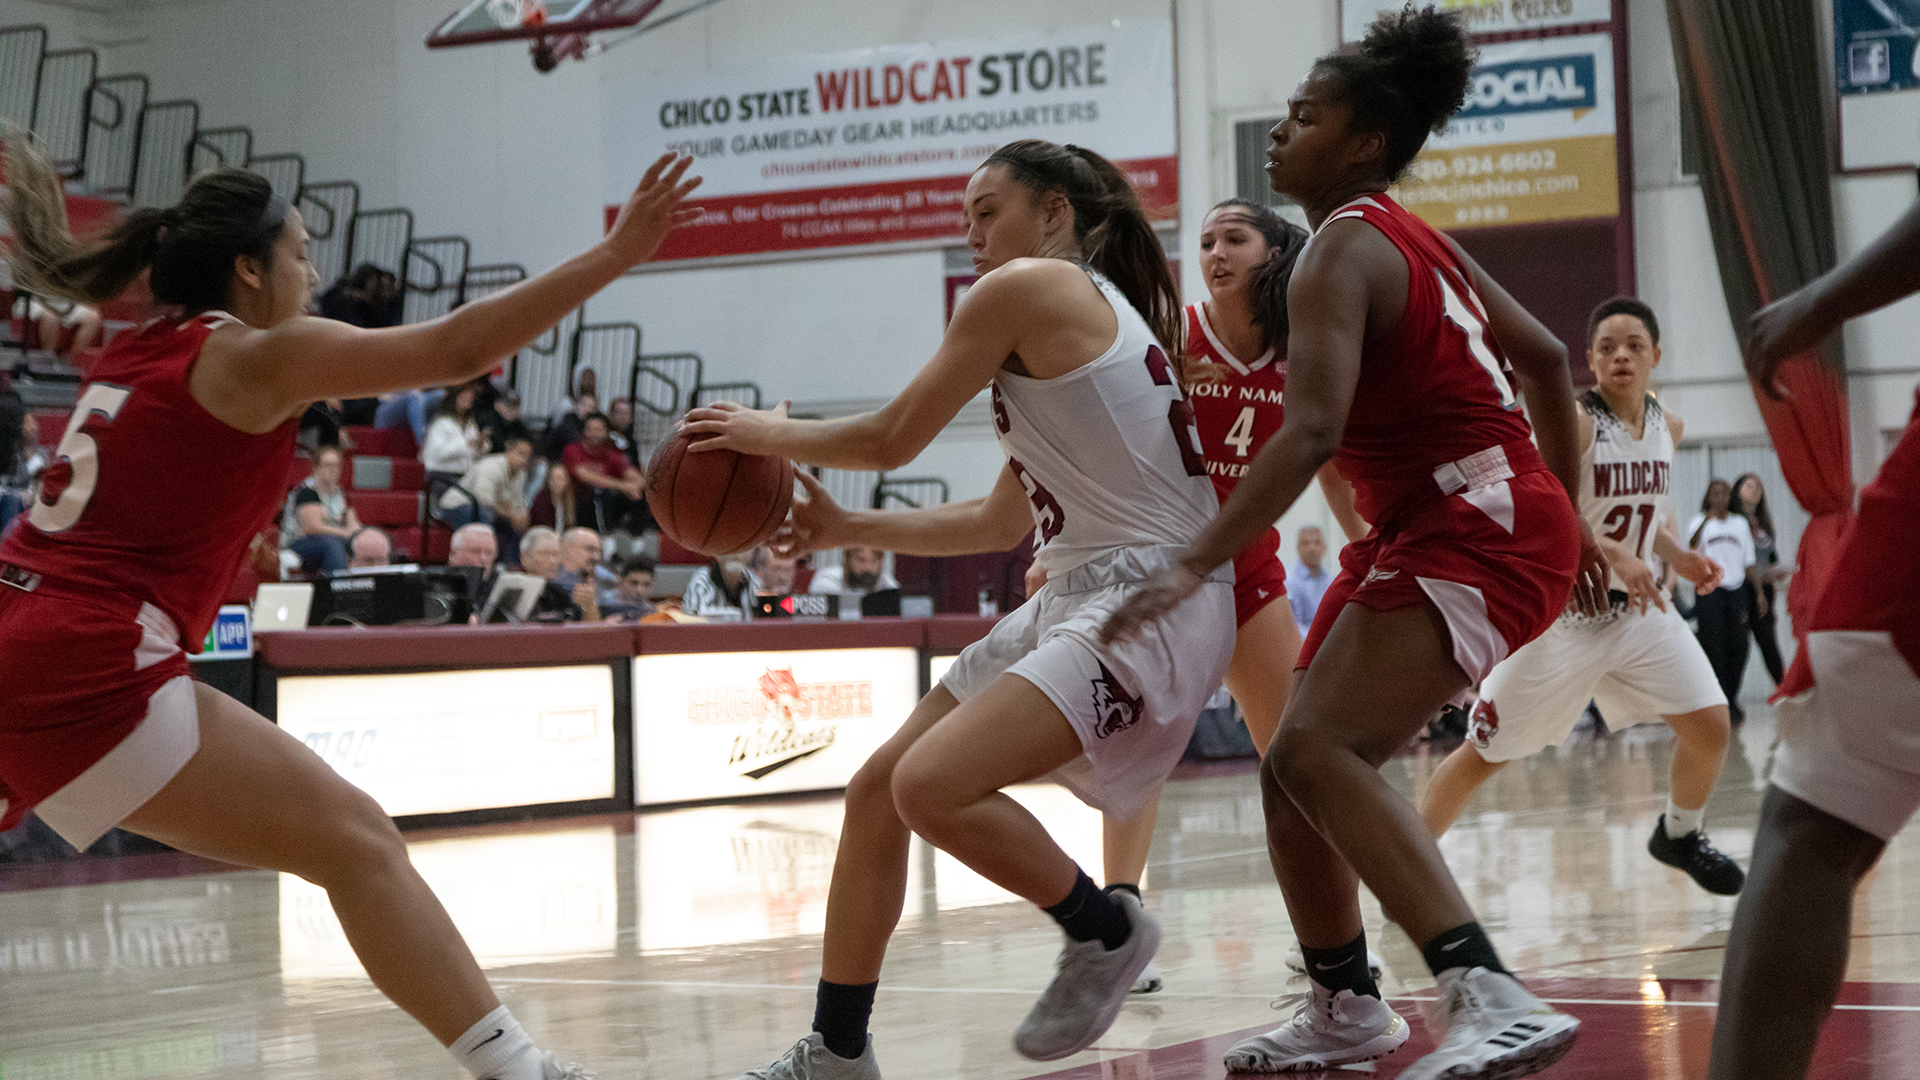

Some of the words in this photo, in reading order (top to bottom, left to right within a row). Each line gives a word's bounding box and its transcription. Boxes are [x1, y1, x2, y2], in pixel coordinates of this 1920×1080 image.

[659, 96, 730, 128] CHICO
[738, 88, 809, 122] STATE
[815, 57, 972, 113] WILDCAT
[979, 44, 1105, 96] STORE
[731, 128, 835, 155] GAMEDAY
[843, 119, 903, 144] GEAR
[910, 101, 1099, 137] HEADQUARTERS
[1239, 386, 1285, 407] NAM
[1224, 405, 1256, 457] 4
[28, 383, 132, 533] 5
[1603, 504, 1656, 559] 21
[219, 622, 246, 645] APP
[688, 686, 766, 726] CHICO
[797, 680, 873, 721] STATE
